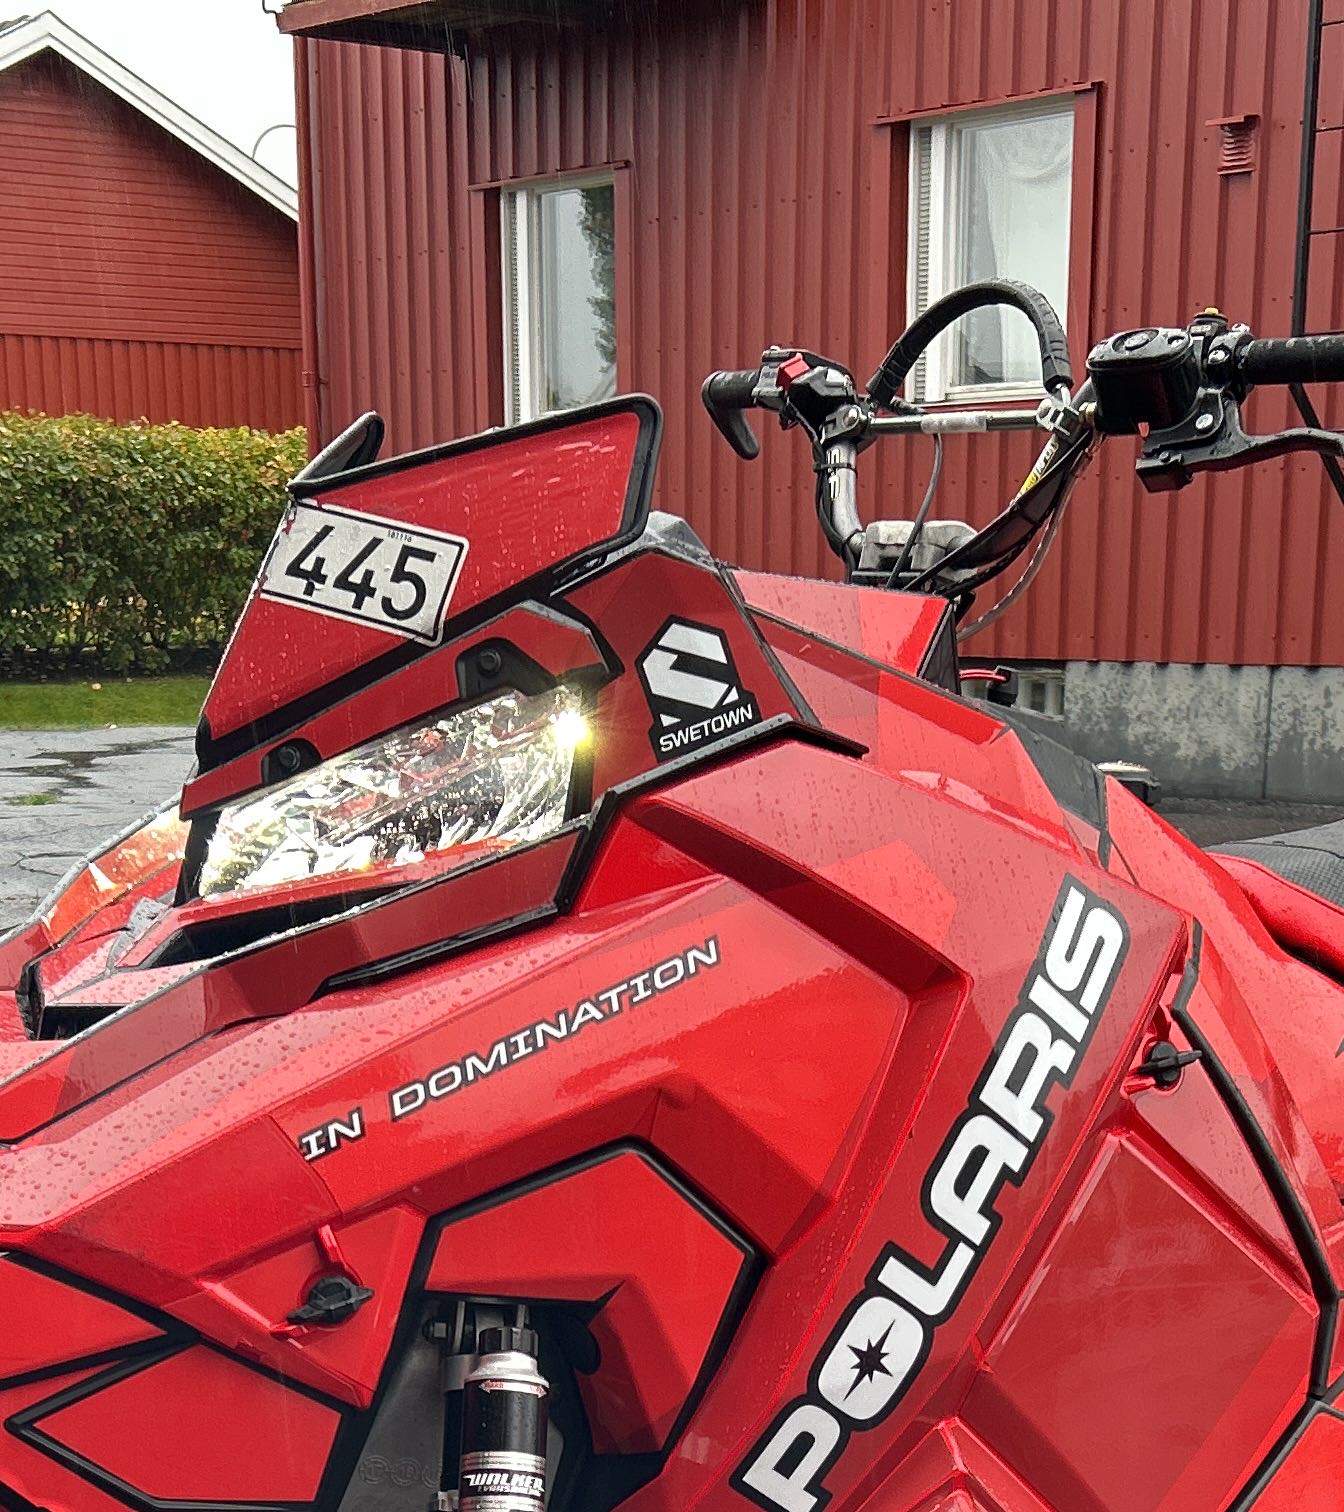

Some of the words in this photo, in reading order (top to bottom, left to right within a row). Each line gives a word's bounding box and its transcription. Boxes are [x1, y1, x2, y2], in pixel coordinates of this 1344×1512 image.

[285, 525, 437, 620] 445
[659, 703, 753, 752] SWETOWN
[301, 1112, 362, 1161] IN
[393, 939, 719, 1120] DOMINATION
[463, 1473, 545, 1492] WALKER
